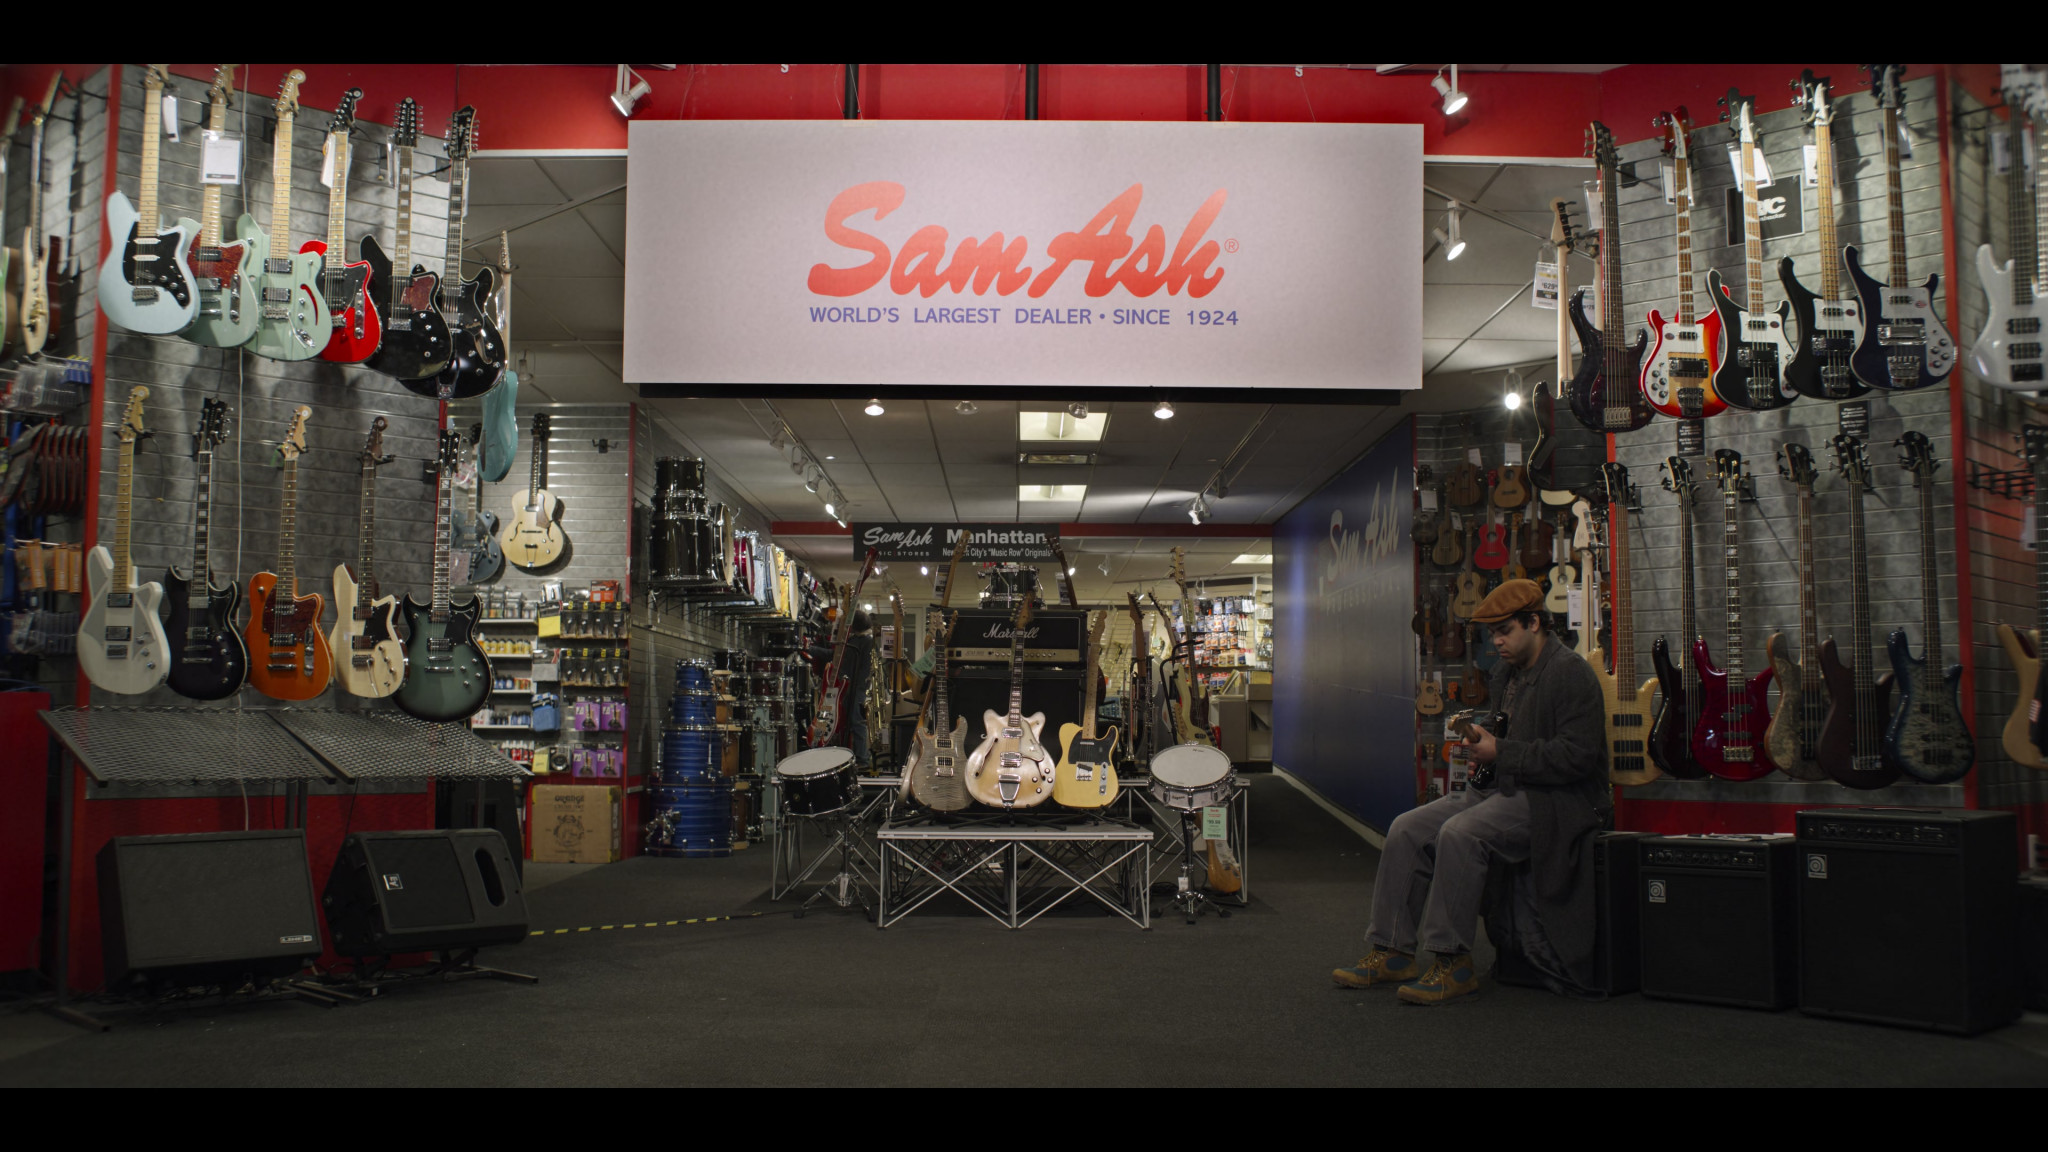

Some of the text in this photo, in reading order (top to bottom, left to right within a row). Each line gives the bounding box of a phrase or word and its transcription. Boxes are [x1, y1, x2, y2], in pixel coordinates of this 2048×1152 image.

[807, 180, 1228, 299] Sam Ash
[809, 306, 1239, 326] WORLD'S LARGEST DEALER SINCE 1924
[1327, 465, 1400, 583] Sam Ash
[863, 526, 933, 549] Sam Ash
[970, 547, 987, 559] City's
